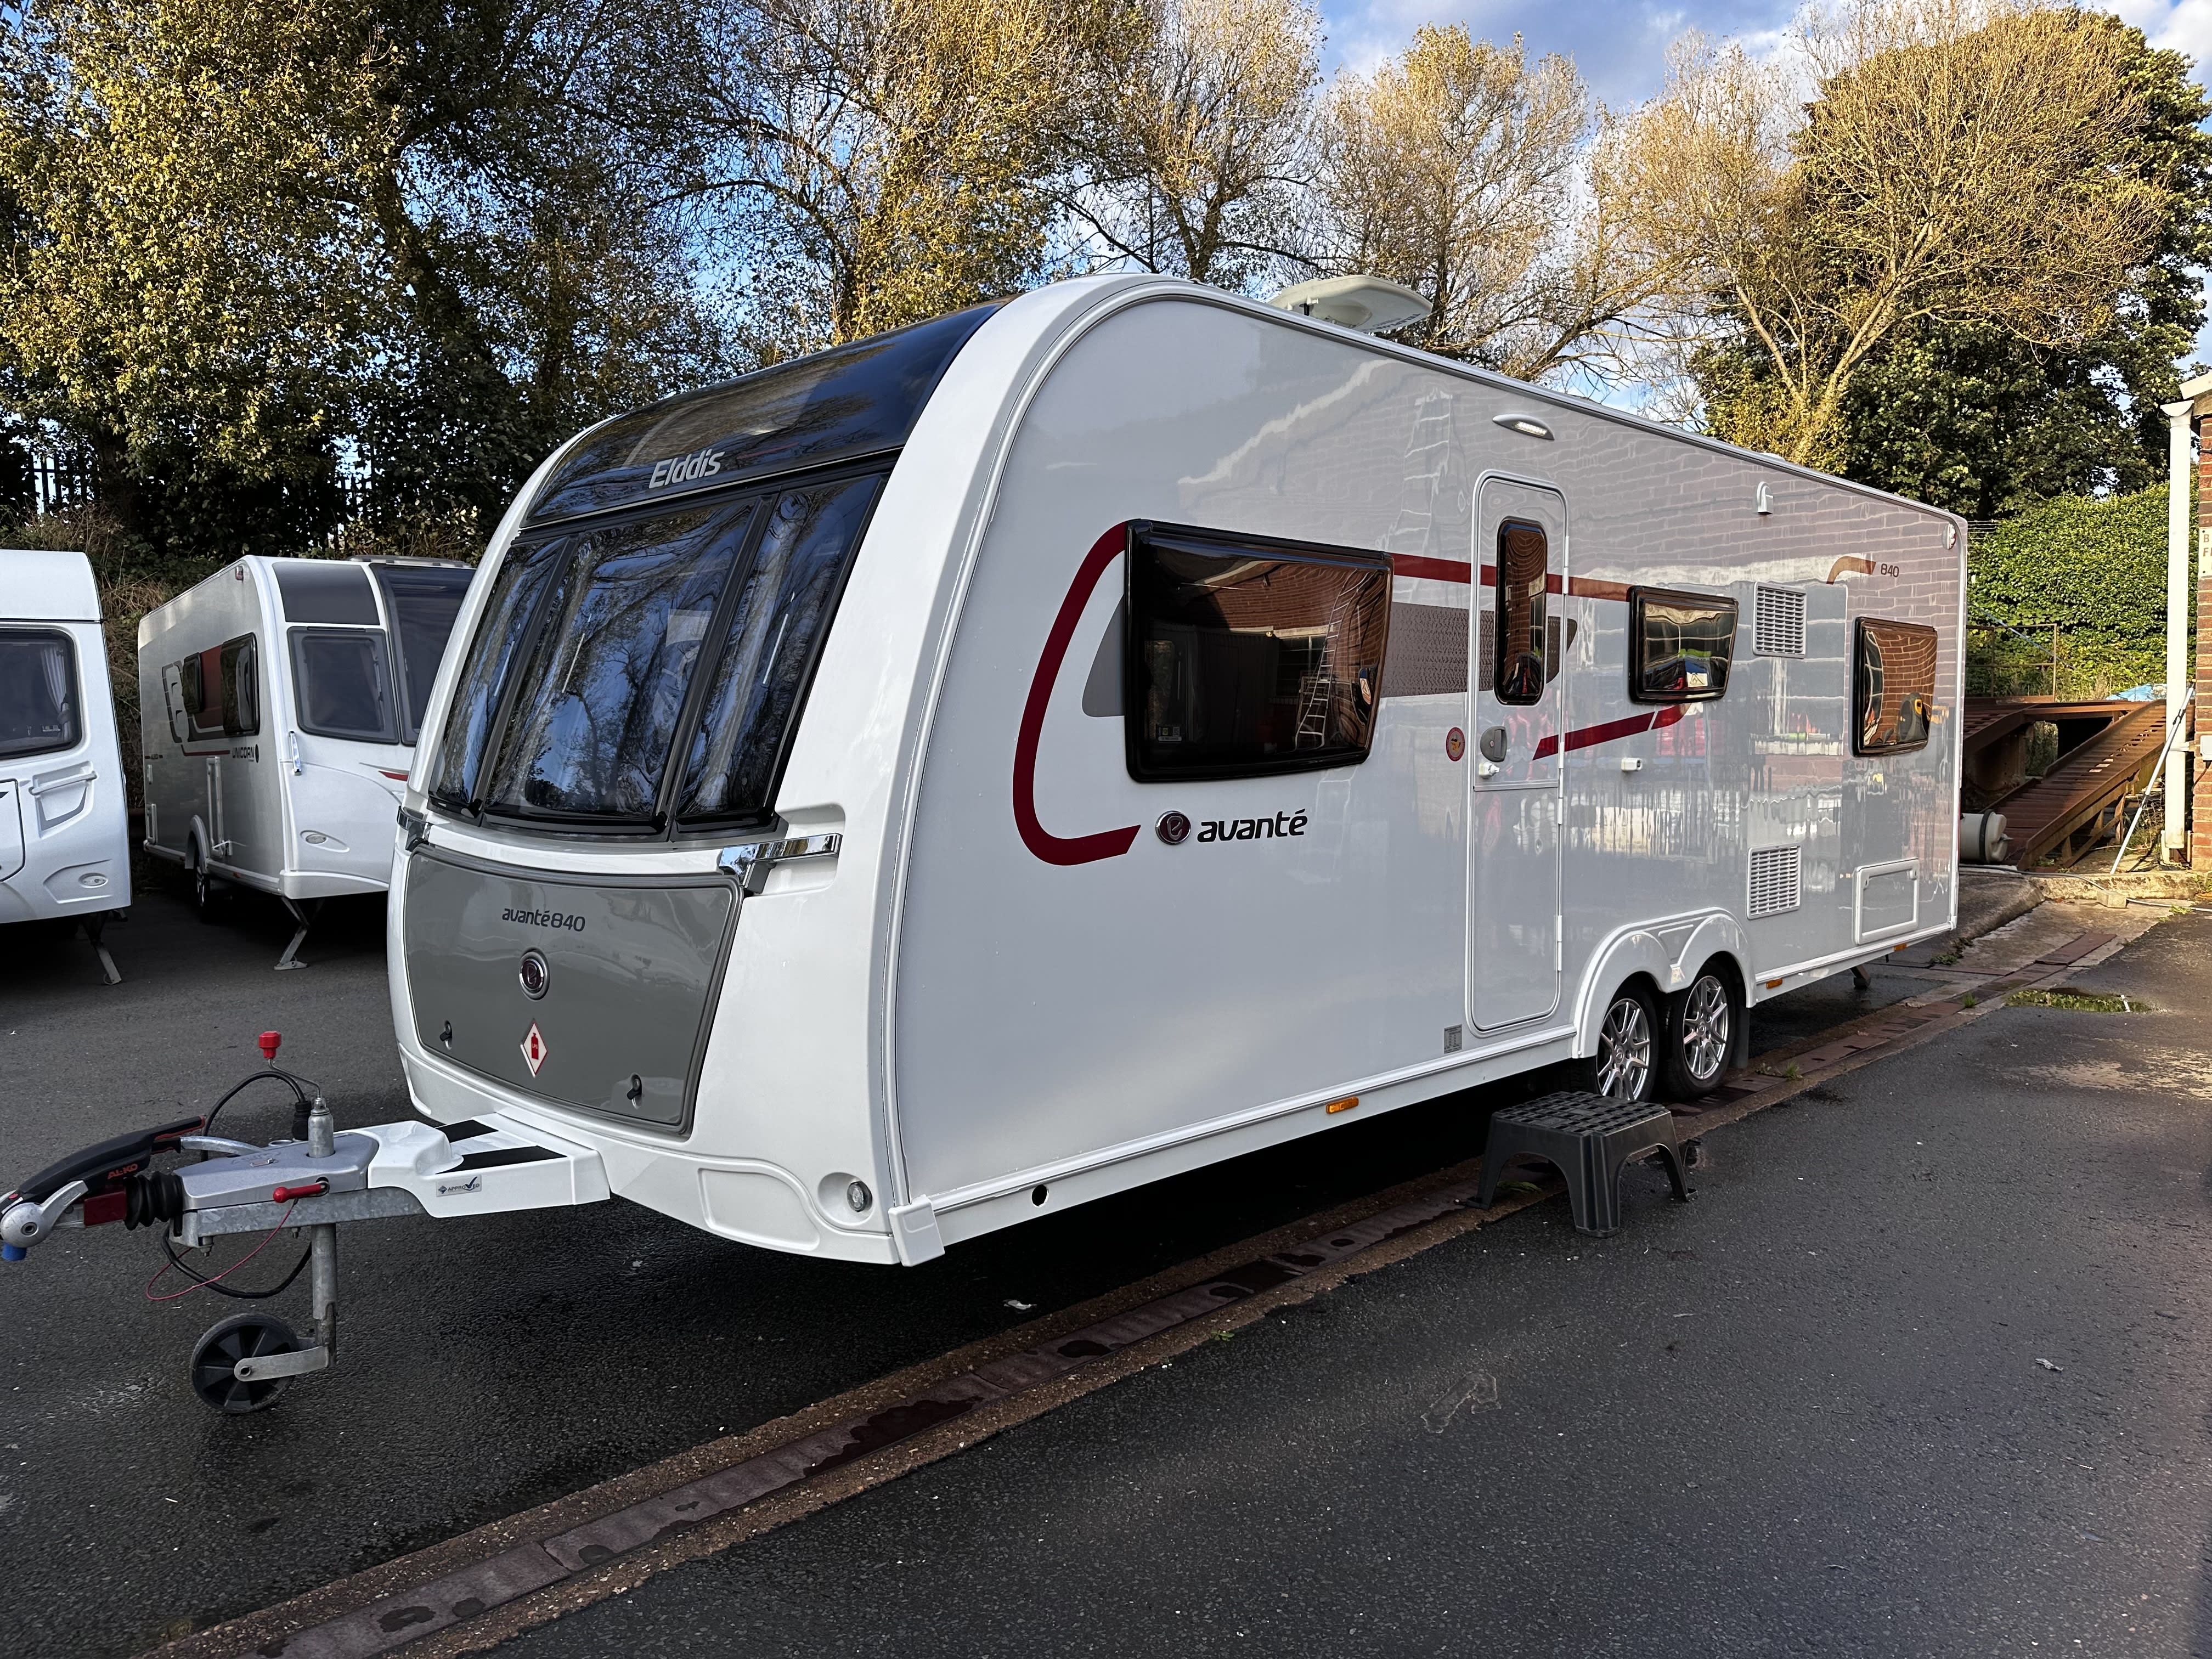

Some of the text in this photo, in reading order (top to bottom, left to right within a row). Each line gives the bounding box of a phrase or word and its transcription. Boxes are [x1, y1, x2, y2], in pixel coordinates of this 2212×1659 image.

[648, 448, 726, 489] Elddis
[1881, 563, 1899, 578] 840
[232, 747, 255, 759] UNICORN
[1197, 808, 1308, 843] avanté
